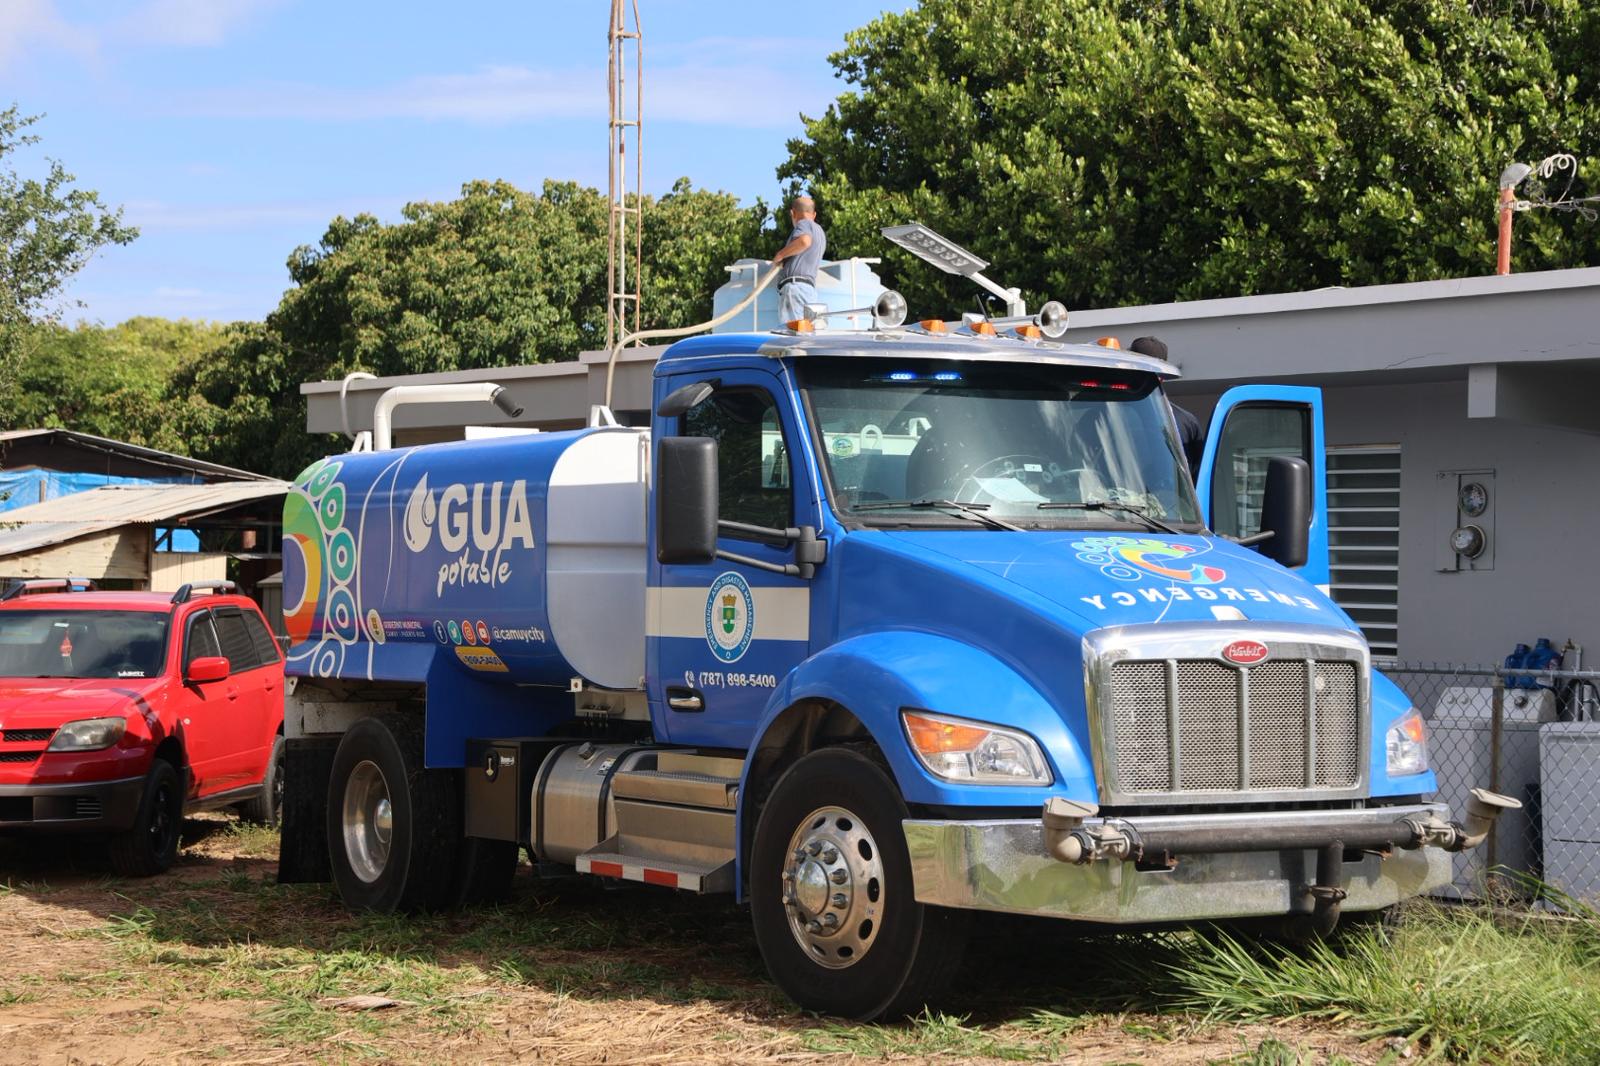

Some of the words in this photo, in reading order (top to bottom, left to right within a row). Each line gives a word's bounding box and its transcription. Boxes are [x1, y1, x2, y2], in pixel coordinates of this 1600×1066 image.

[436, 547, 513, 598] potable
[492, 626, 545, 643] @camuycity
[699, 672, 725, 689] (787)
[727, 673, 776, 688] 898-5400
